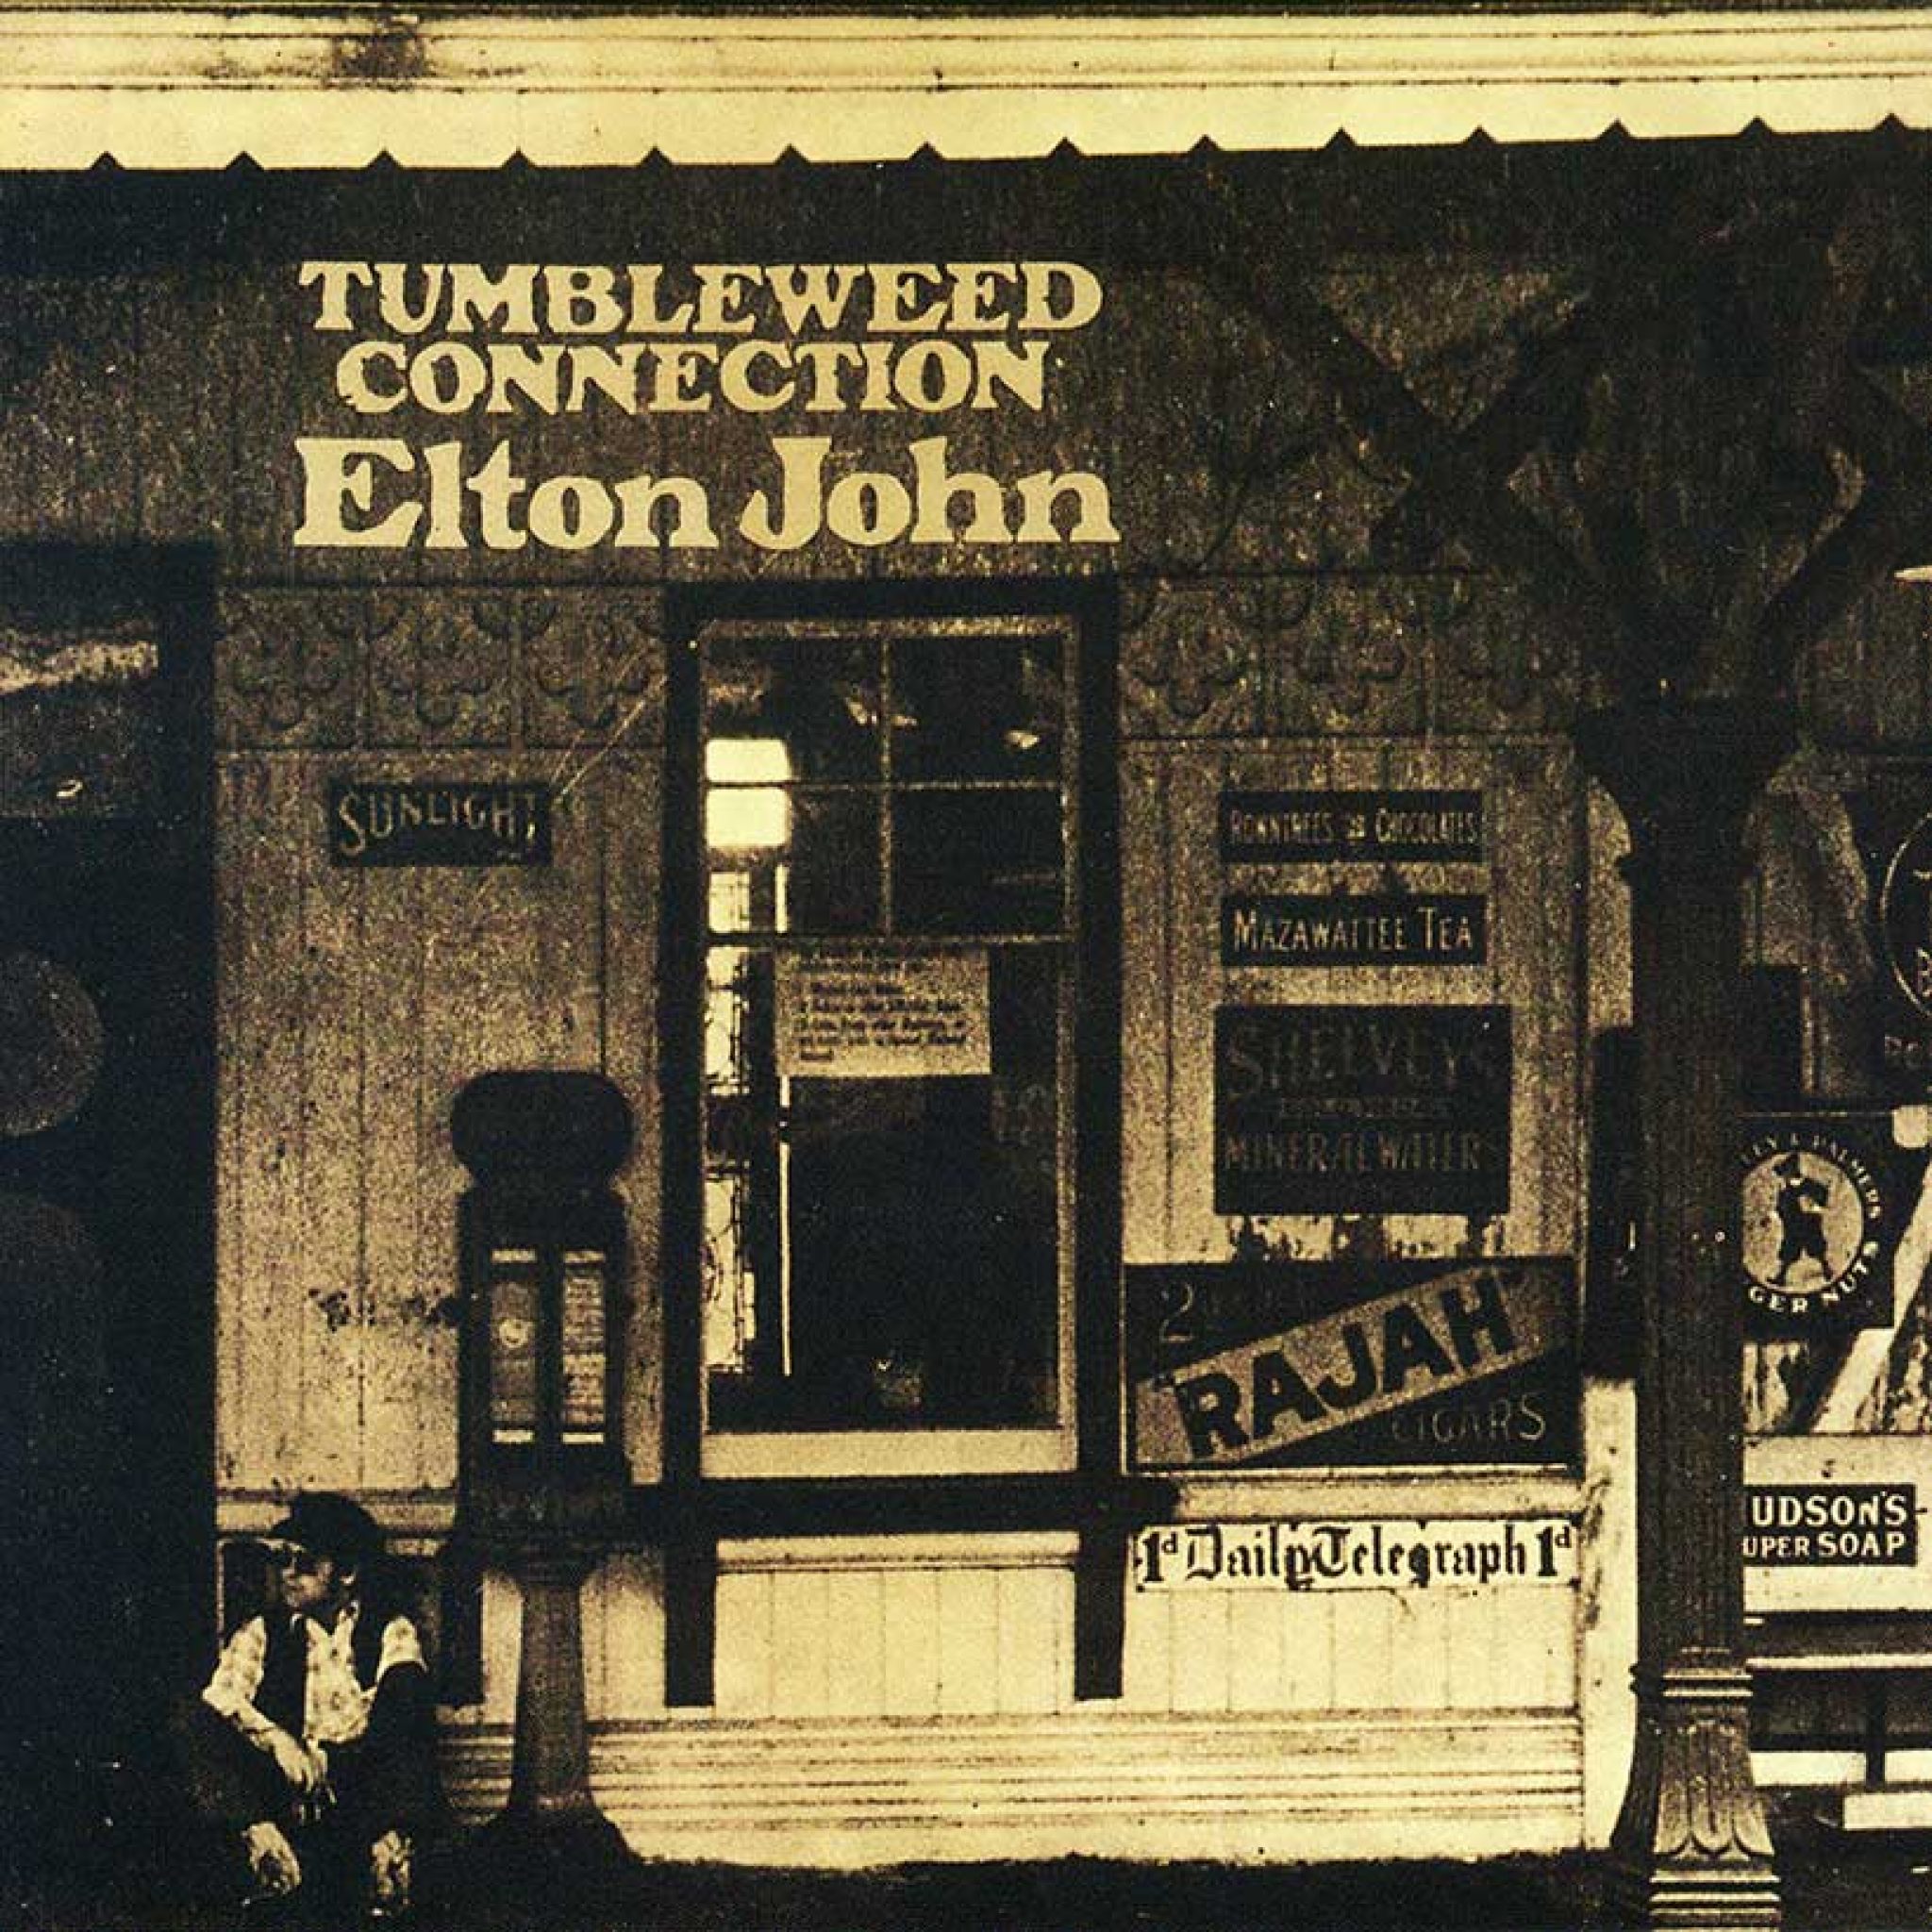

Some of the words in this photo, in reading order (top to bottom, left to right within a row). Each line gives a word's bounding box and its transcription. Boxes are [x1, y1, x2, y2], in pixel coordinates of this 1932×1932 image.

[1233, 908, 1407, 952] MAZAWATTEE
[1417, 907, 1474, 952] TEA
[1748, 1285, 1808, 1314] GER
[1174, 1275, 1514, 1458] RAJAH
[1752, 1491, 1907, 1527] UDSON'S
[1185, 1524, 1314, 1591] Daily
[1311, 1524, 1526, 1589] Telegraph
[1743, 1536, 1810, 1558] UPER
[1817, 1530, 1907, 1557] SOAP
